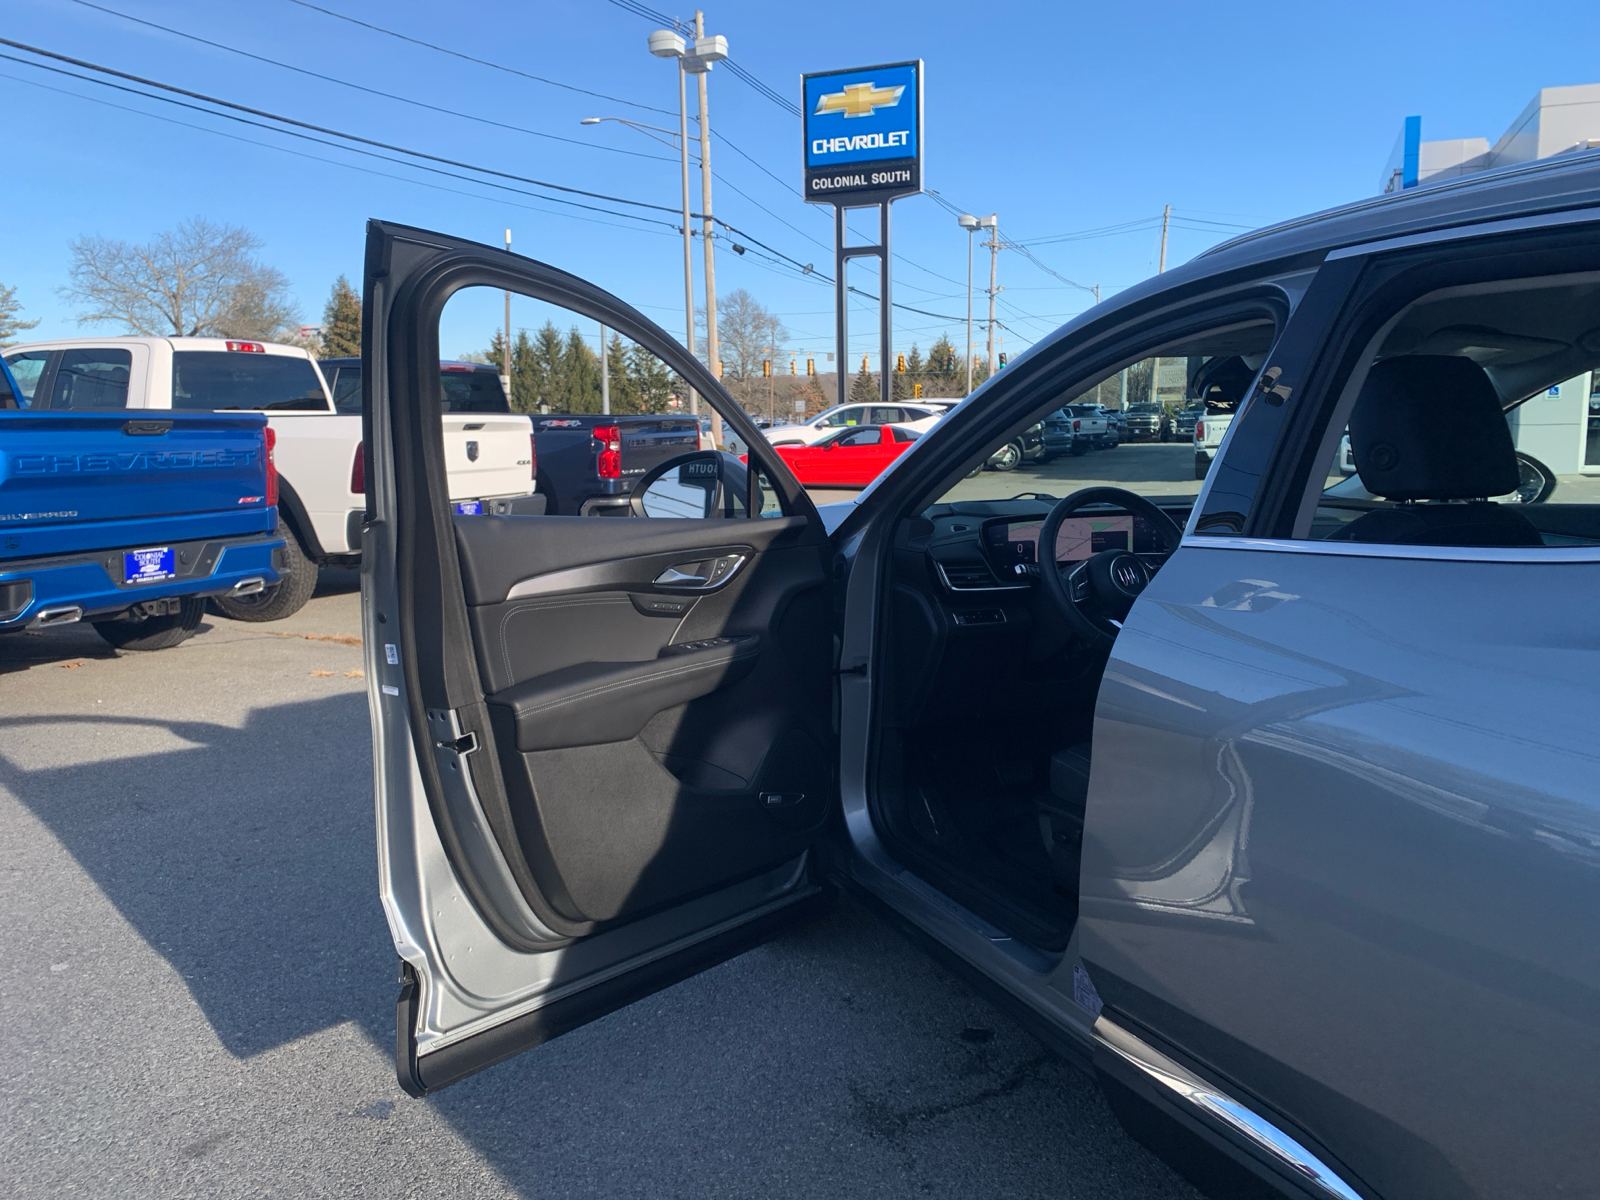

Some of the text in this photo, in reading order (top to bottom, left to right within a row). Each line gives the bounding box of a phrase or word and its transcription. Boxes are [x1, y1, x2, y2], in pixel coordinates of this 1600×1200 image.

[812, 130, 910, 155] CHEVROLET
[812, 170, 911, 190] COLONIAL SOUTH
[14, 450, 257, 474] CHEVROLET
[0, 510, 79, 521] SILVERADO
[134, 551, 166, 562] COLONIAL
[139, 557, 161, 567] SOUTH
